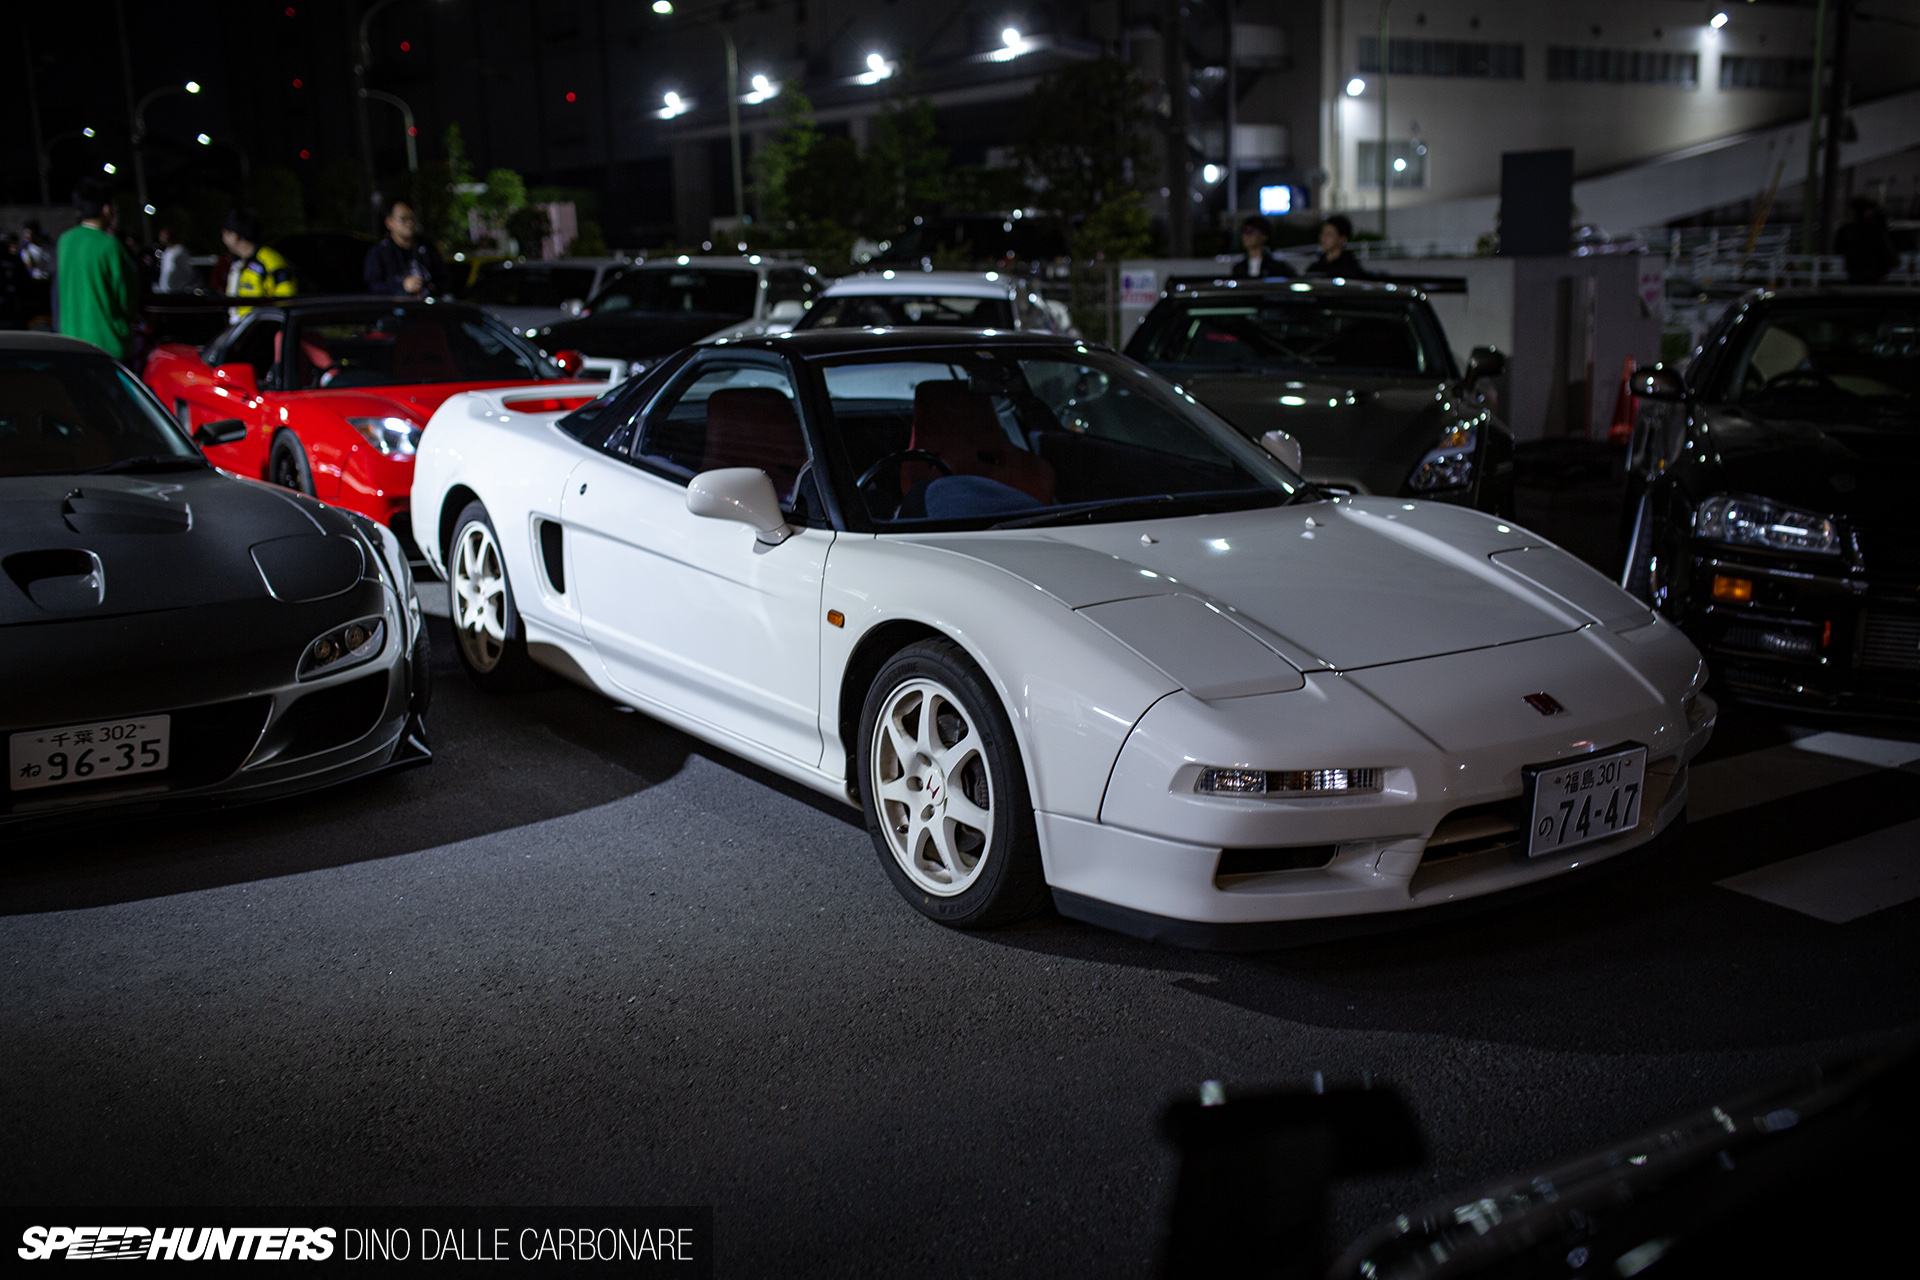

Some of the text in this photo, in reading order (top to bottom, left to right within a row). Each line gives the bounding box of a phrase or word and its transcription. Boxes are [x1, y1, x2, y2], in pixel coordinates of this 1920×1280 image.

[50, 723, 137, 748] 千葉 302
[19, 738, 161, 781] ね 96-35
[1563, 759, 1622, 795] 福島 301
[1538, 782, 1639, 845] の 74-47
